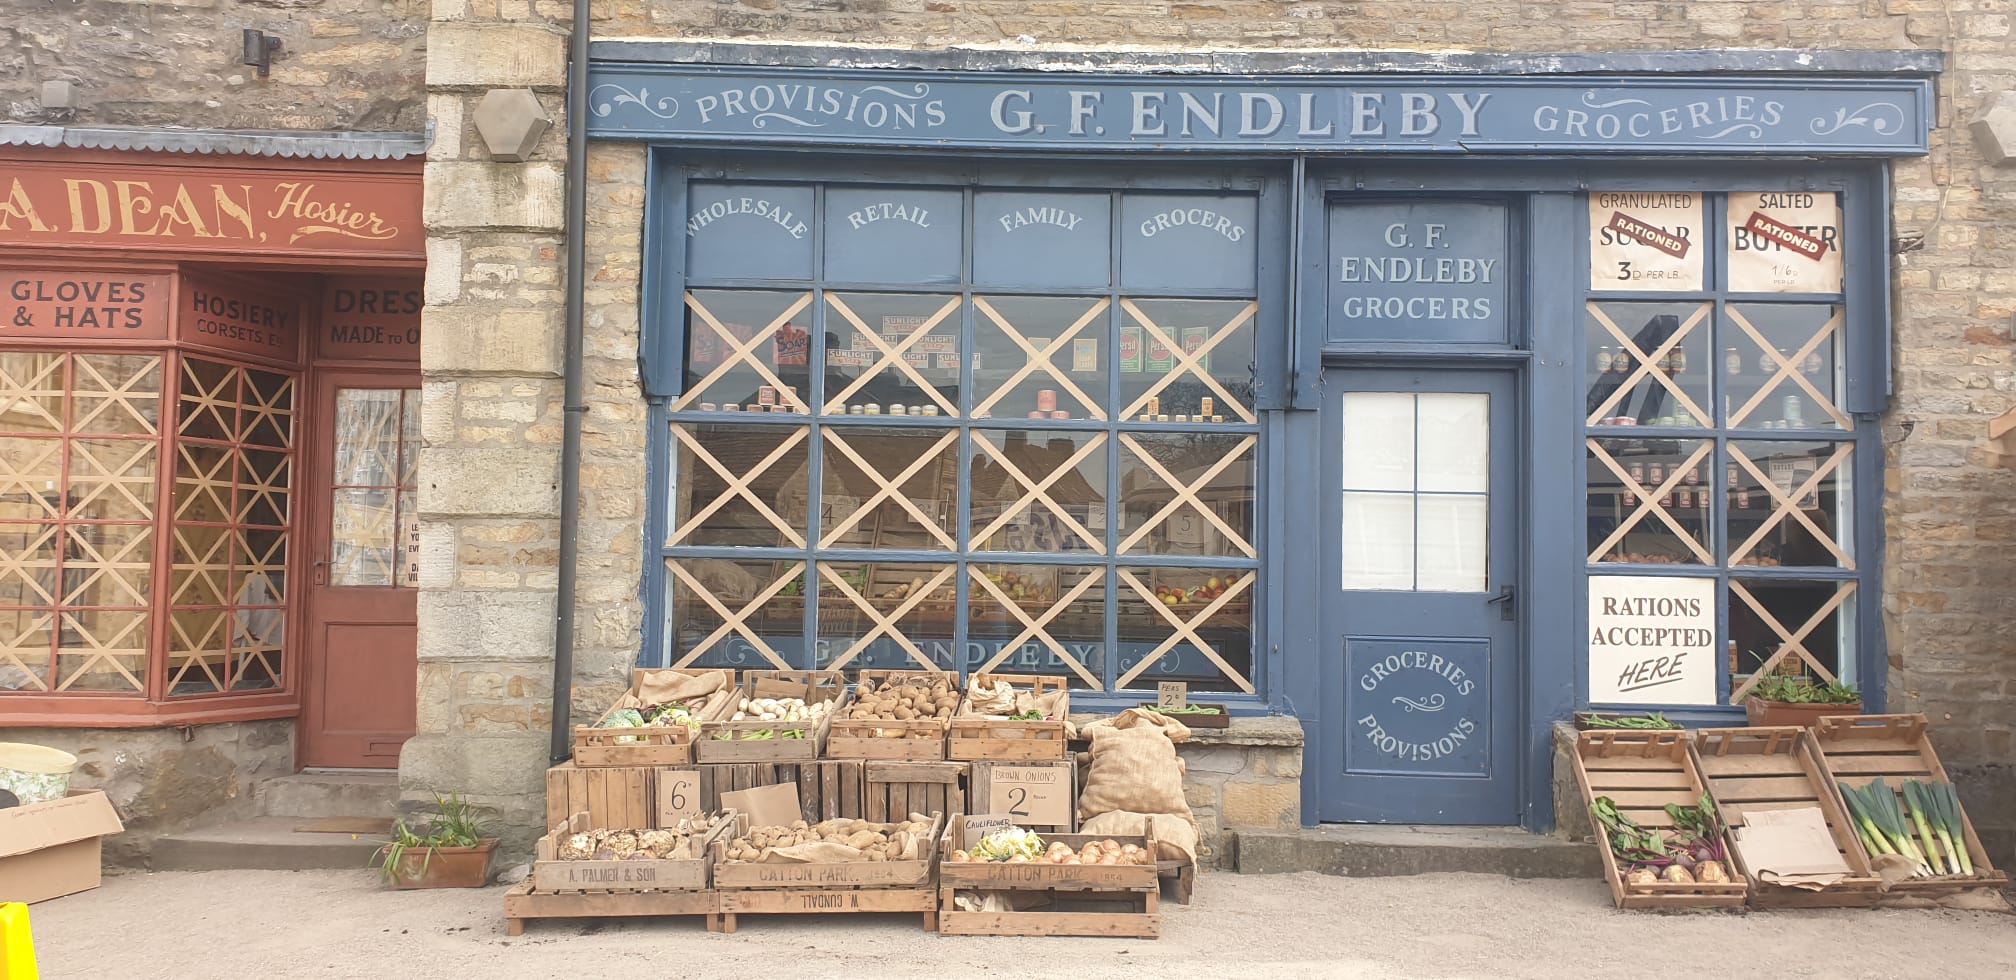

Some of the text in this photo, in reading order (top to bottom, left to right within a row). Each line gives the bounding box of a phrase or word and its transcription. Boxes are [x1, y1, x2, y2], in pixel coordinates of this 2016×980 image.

[697, 83, 946, 131] PROVISIONS
[990, 89, 1493, 138] G. F. ENDLEBY
[1533, 94, 1786, 140] GROCERIES
[0, 177, 399, 243] A. DEAN, Hosier
[1599, 193, 1692, 209] GRANULATED
[1759, 193, 1814, 209] SALTED
[686, 197, 807, 240] WHOLESALE
[847, 202, 931, 230] RETAIL
[999, 206, 1082, 232] FAMILY
[1140, 208, 1245, 242] GROCERS
[1384, 223, 1450, 249] G. F.
[1600, 225, 1692, 246] SUR
[1616, 218, 1682, 252] RATIONED
[1754, 218, 1819, 253] RATIONED
[1340, 256, 1496, 284] ENDLEBY
[1647, 270, 1664, 279] PER
[11, 280, 146, 304] GLOVES
[13, 307, 143, 329] & HATS
[193, 290, 288, 329] HOSIERY
[1343, 296, 1492, 320] GROCERS
[885, 317, 929, 325] SUNLIGHT
[331, 325, 384, 344] MADE
[1121, 340, 1136, 351] ersil
[1150, 339, 1168, 354] Pers
[829, 351, 871, 359] SUNLIGHT
[1602, 596, 1700, 618] RATIONS
[1591, 626, 1712, 648] ACCEPTED
[1360, 651, 1475, 696] GROCERIES
[1617, 652, 1688, 687] HERE
[1357, 713, 1475, 761] PROVISIONS
[995, 770, 1057, 783] BROWN ONIONS
[1008, 787, 1029, 816] 2
[965, 818, 1010, 830] CAULIFLOWER
[582, 868, 619, 882] PALMER
[624, 868, 631, 881] &
[636, 867, 656, 882] SON
[1049, 867, 1082, 880] PARK
[801, 894, 842, 908] CUNDALL
